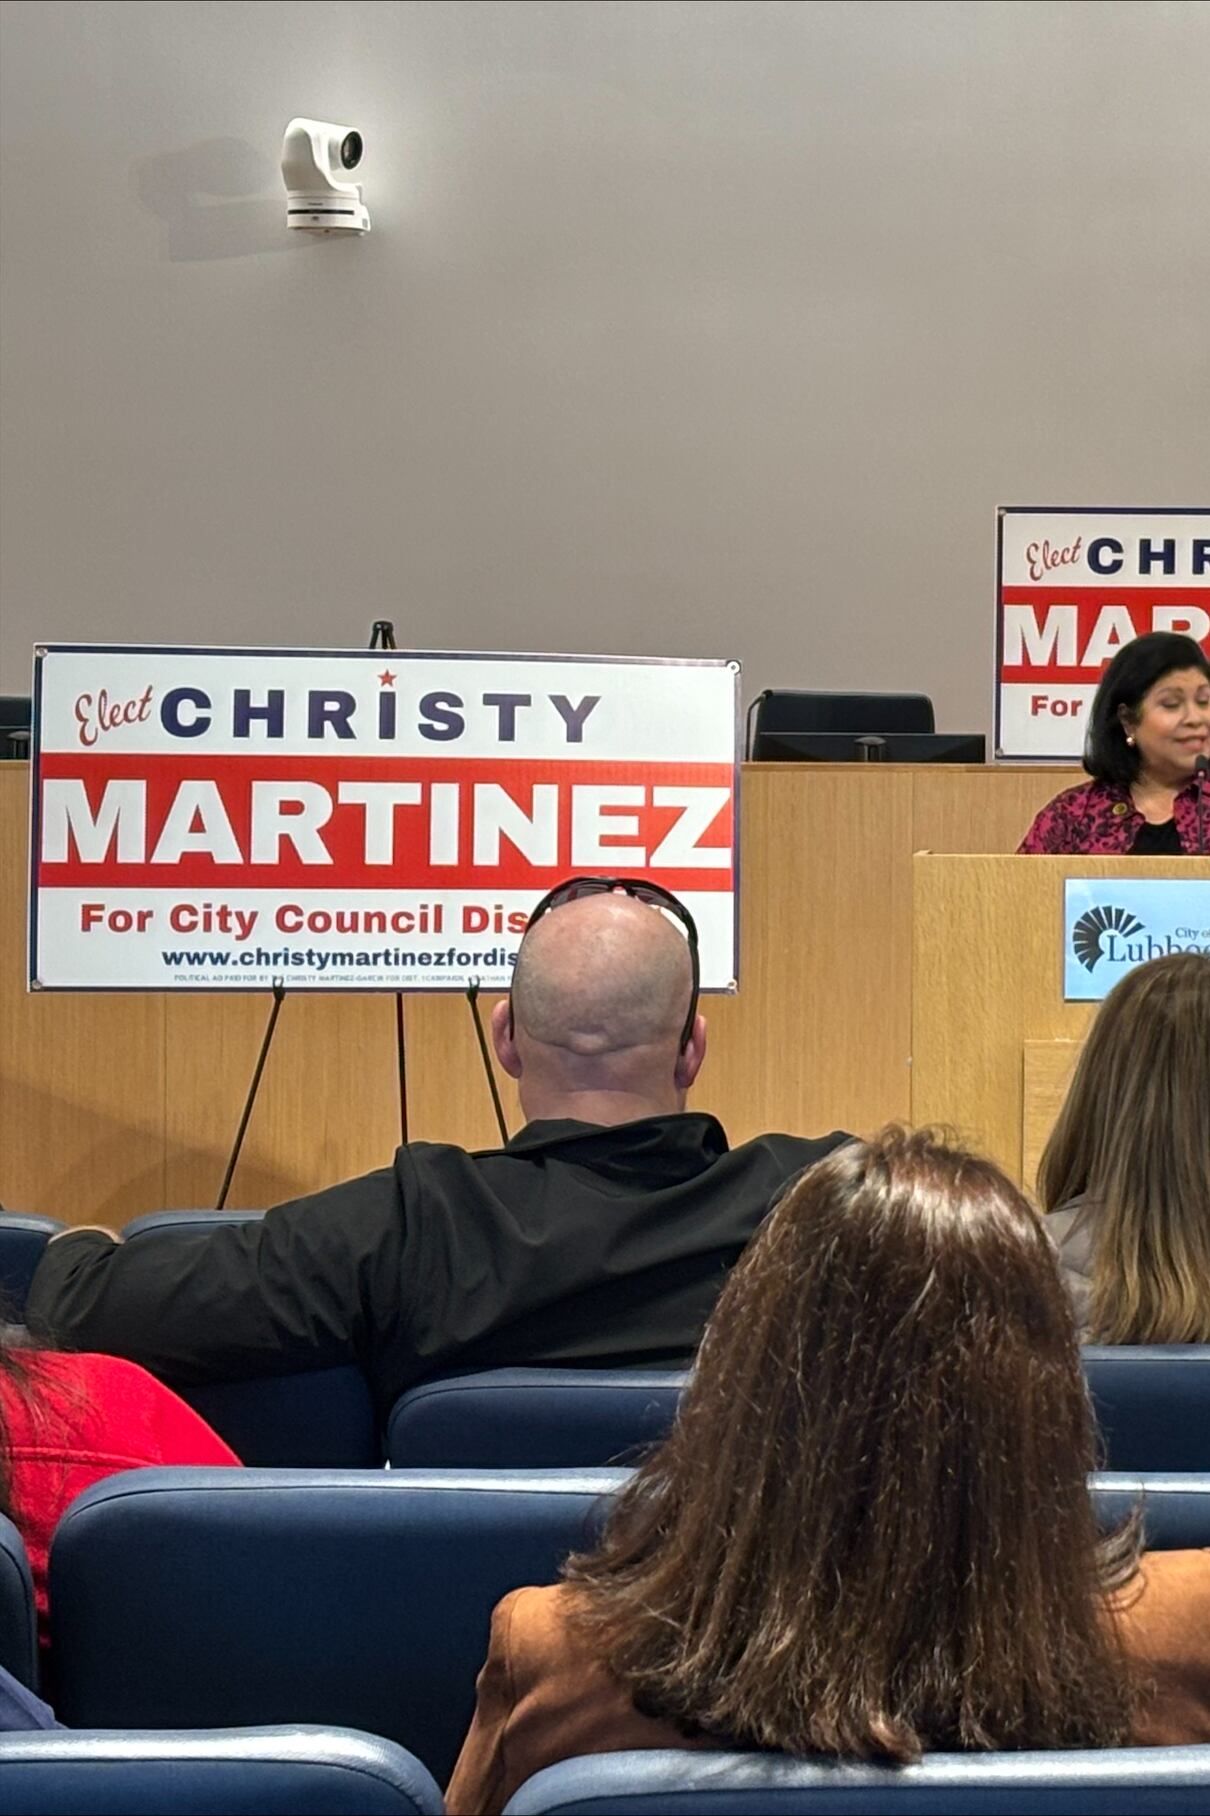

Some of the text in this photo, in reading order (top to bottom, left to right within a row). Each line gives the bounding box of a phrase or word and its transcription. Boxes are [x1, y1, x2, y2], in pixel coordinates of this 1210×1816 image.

[1026, 536, 1081, 581] Elect
[74, 685, 601, 747] Elect CHRISTY
[1030, 695, 1082, 717] For
[41, 778, 732, 869] MARTINEZ
[81, 904, 154, 932] For
[169, 903, 259, 941] City
[275, 903, 443, 934] Council
[1175, 927, 1199, 940] City
